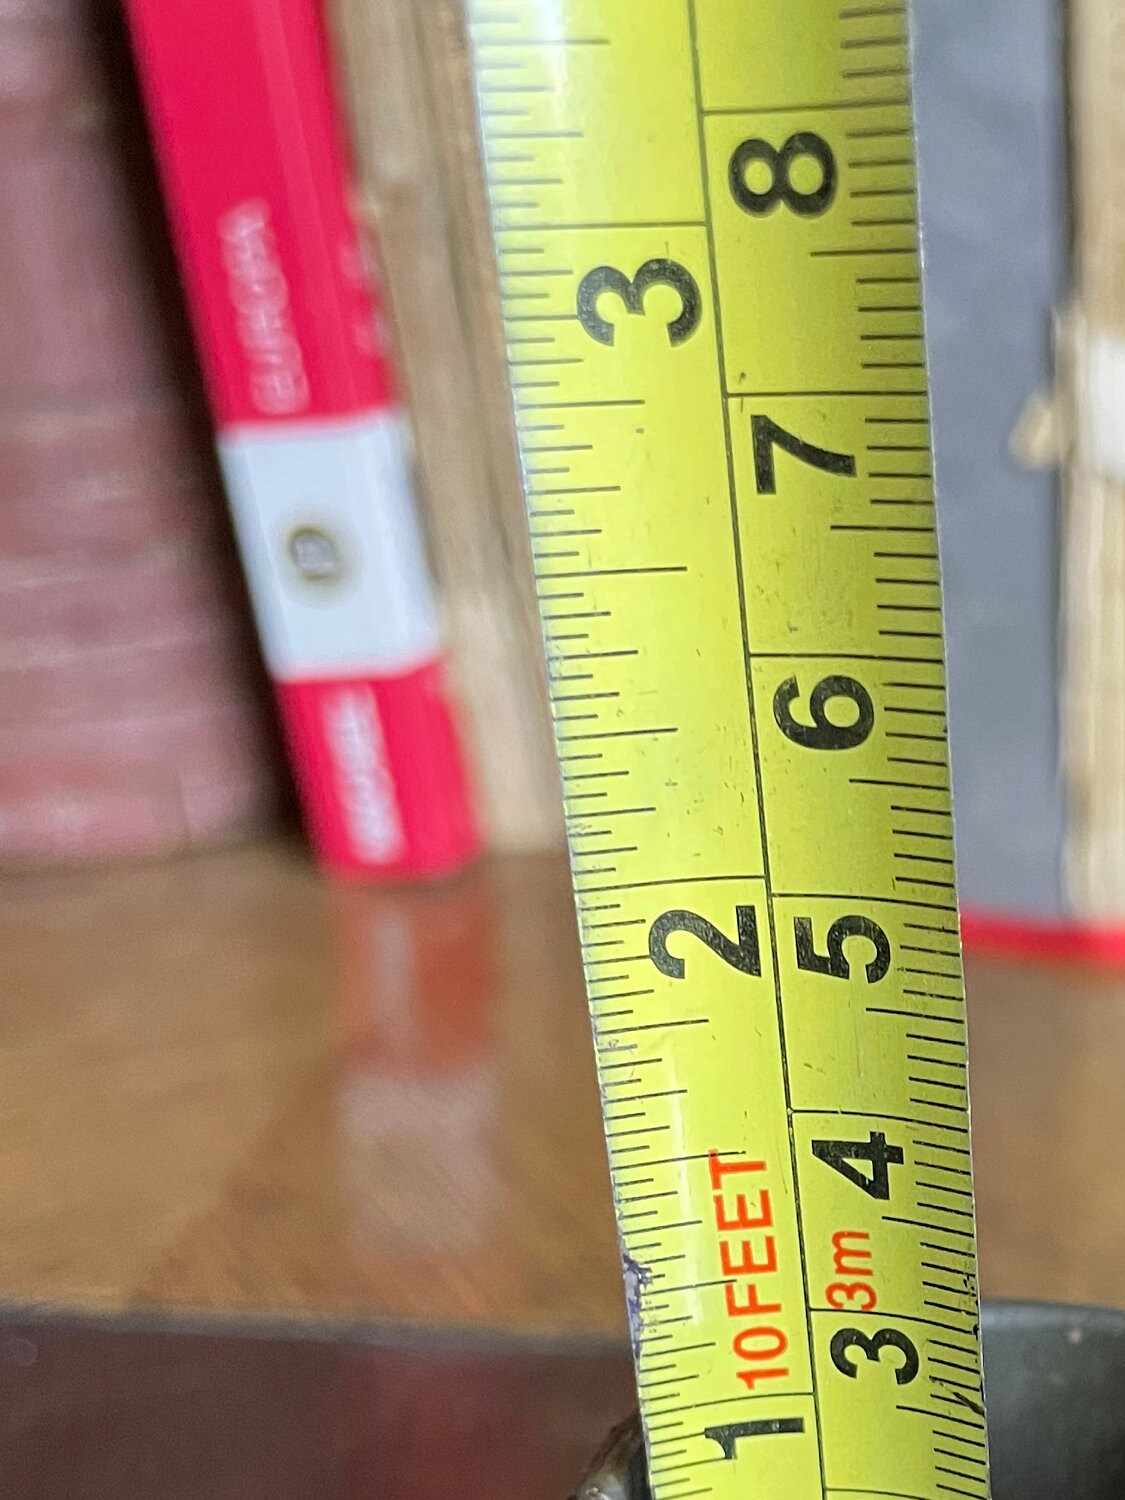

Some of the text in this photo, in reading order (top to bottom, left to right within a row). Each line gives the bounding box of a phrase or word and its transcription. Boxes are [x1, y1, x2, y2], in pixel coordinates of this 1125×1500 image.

[729, 131, 838, 218] 8
[575, 257, 702, 348] 3
[750, 414, 857, 494] 7
[772, 674, 875, 751] 6
[648, 904, 762, 982] 2
[793, 914, 891, 984] 5
[811, 1130, 905, 1201] 4
[825, 1230, 877, 1313] 3m
[829, 1327, 920, 1386] 3
[703, 1417, 806, 1461] 1
